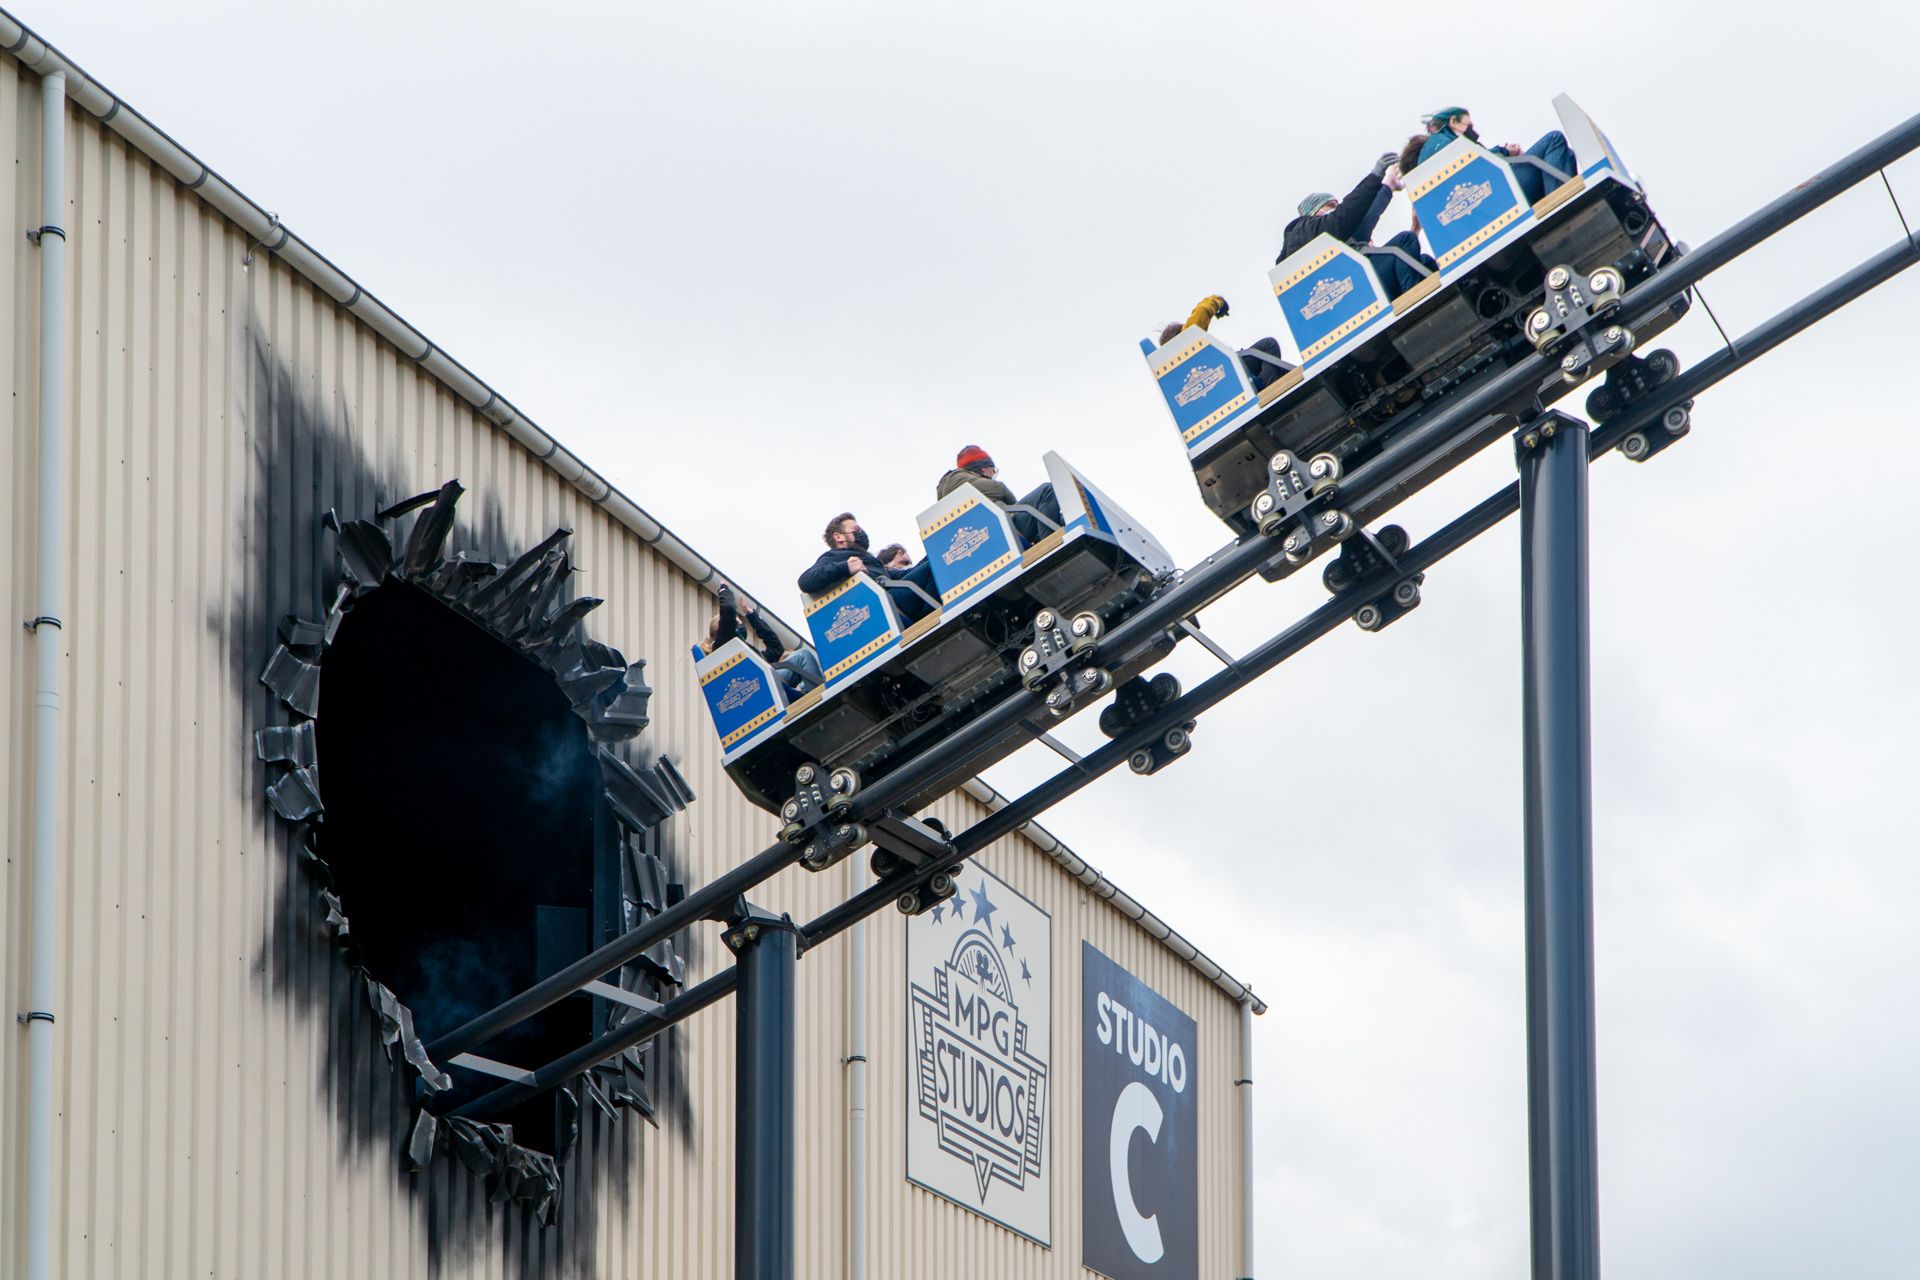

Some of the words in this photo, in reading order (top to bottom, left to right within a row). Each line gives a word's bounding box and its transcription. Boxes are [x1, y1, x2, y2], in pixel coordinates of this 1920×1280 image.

[1445, 200, 1468, 218] STUDIO
[1307, 295, 1330, 312] STUDIO
[1181, 383, 1204, 400] STUDIO
[948, 543, 968, 558] STUDIO
[830, 621, 849, 636] STUDIO
[955, 985, 1009, 1056] MPG
[1096, 991, 1187, 1093] STUDIO
[936, 1038, 1025, 1145] STUDIOS
[1110, 1081, 1164, 1264] C
